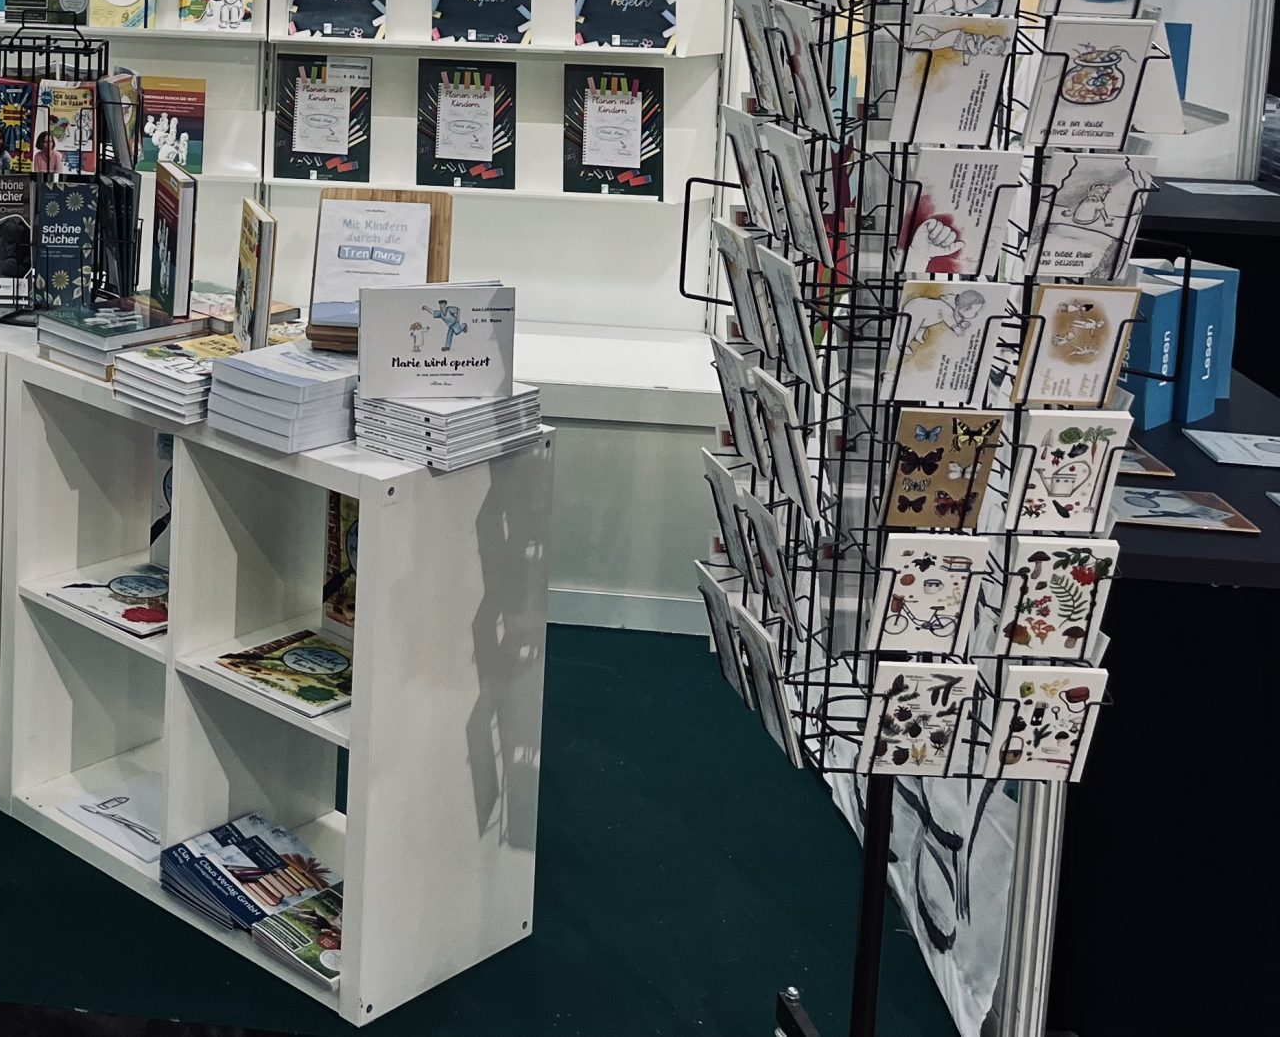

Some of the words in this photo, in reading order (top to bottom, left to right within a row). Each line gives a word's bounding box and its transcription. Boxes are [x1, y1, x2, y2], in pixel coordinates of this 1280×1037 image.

[302, 84, 326, 93] Planen
[329, 85, 344, 93] mit
[307, 94, 337, 103] Kindern
[445, 89, 470, 99] Planen
[473, 91, 488, 99] mit
[591, 95, 617, 105] Planen
[620, 97, 636, 105] mit
[598, 106, 627, 115] Kindern
[42, 223, 82, 234] schöne
[342, 219, 361, 230] Mit
[365, 220, 408, 232] Kindern
[41, 234, 80, 244] bücher
[346, 232, 381, 243] durch
[385, 233, 401, 244] die
[1158, 330, 1171, 387] Lesen
[1201, 324, 1215, 381] Lesen
[391, 356, 422, 368] Marie
[423, 356, 447, 368] wird
[449, 356, 491, 371] operiert
[199, 858, 219, 879] Claus
[217, 875, 239, 897] Verlag
[237, 894, 262, 917] GmbH
